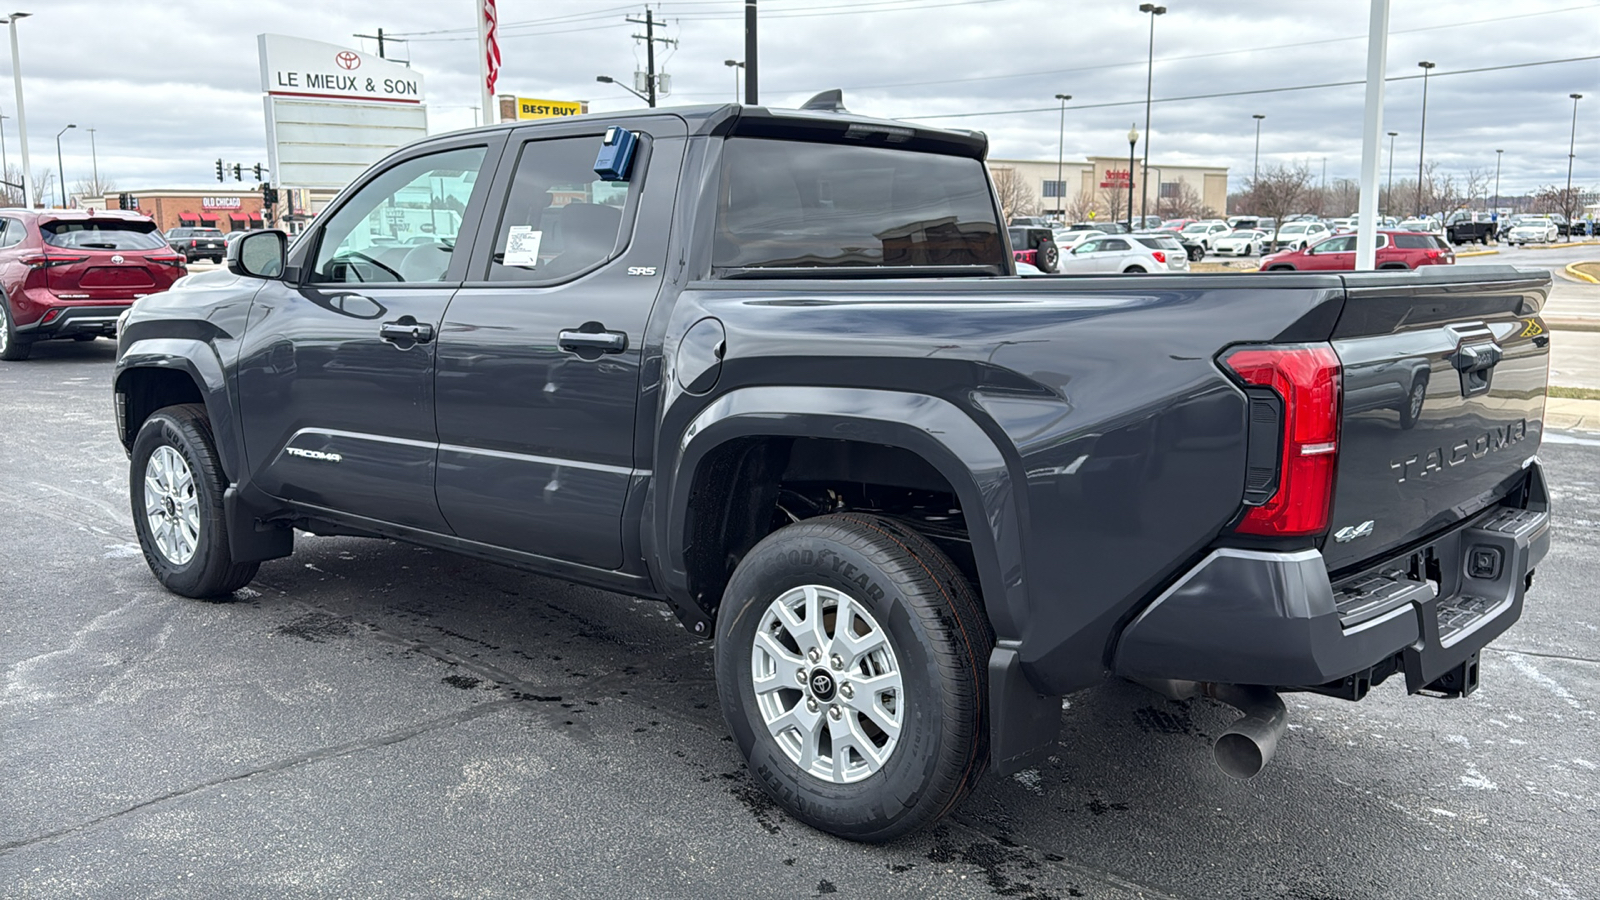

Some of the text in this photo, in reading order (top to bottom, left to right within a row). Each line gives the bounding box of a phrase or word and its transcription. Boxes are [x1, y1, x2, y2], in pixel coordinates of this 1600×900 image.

[277, 71, 418, 95] LE MIEUX & SON
[522, 104, 577, 116] BEST BUY
[203, 197, 241, 207] OLD CHICAGO
[627, 266, 657, 276] SR5
[286, 447, 343, 462] TACOMA
[1390, 418, 1526, 483] TACOMA
